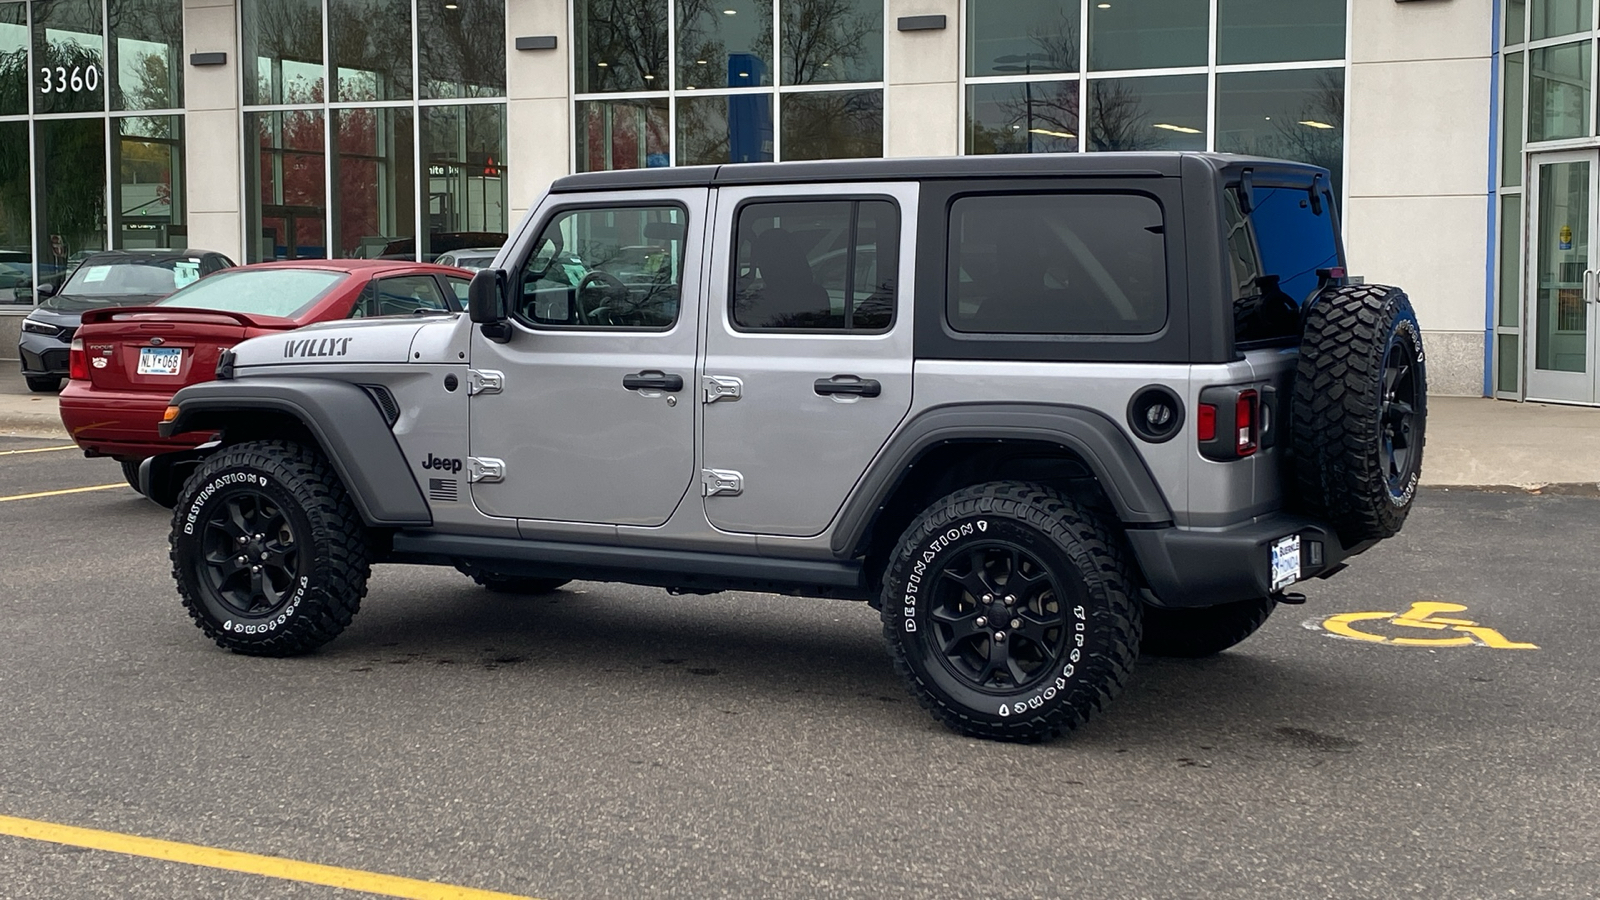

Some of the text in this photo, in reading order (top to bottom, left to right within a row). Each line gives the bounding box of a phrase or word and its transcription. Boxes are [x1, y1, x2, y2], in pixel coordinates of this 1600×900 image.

[41, 65, 98, 93] 3360
[284, 337, 353, 358] WILLYS
[140, 354, 179, 368] NLY 068
[422, 452, 462, 474] Jeep
[184, 472, 257, 535] DESTINATION
[904, 522, 974, 632] DESTINATION
